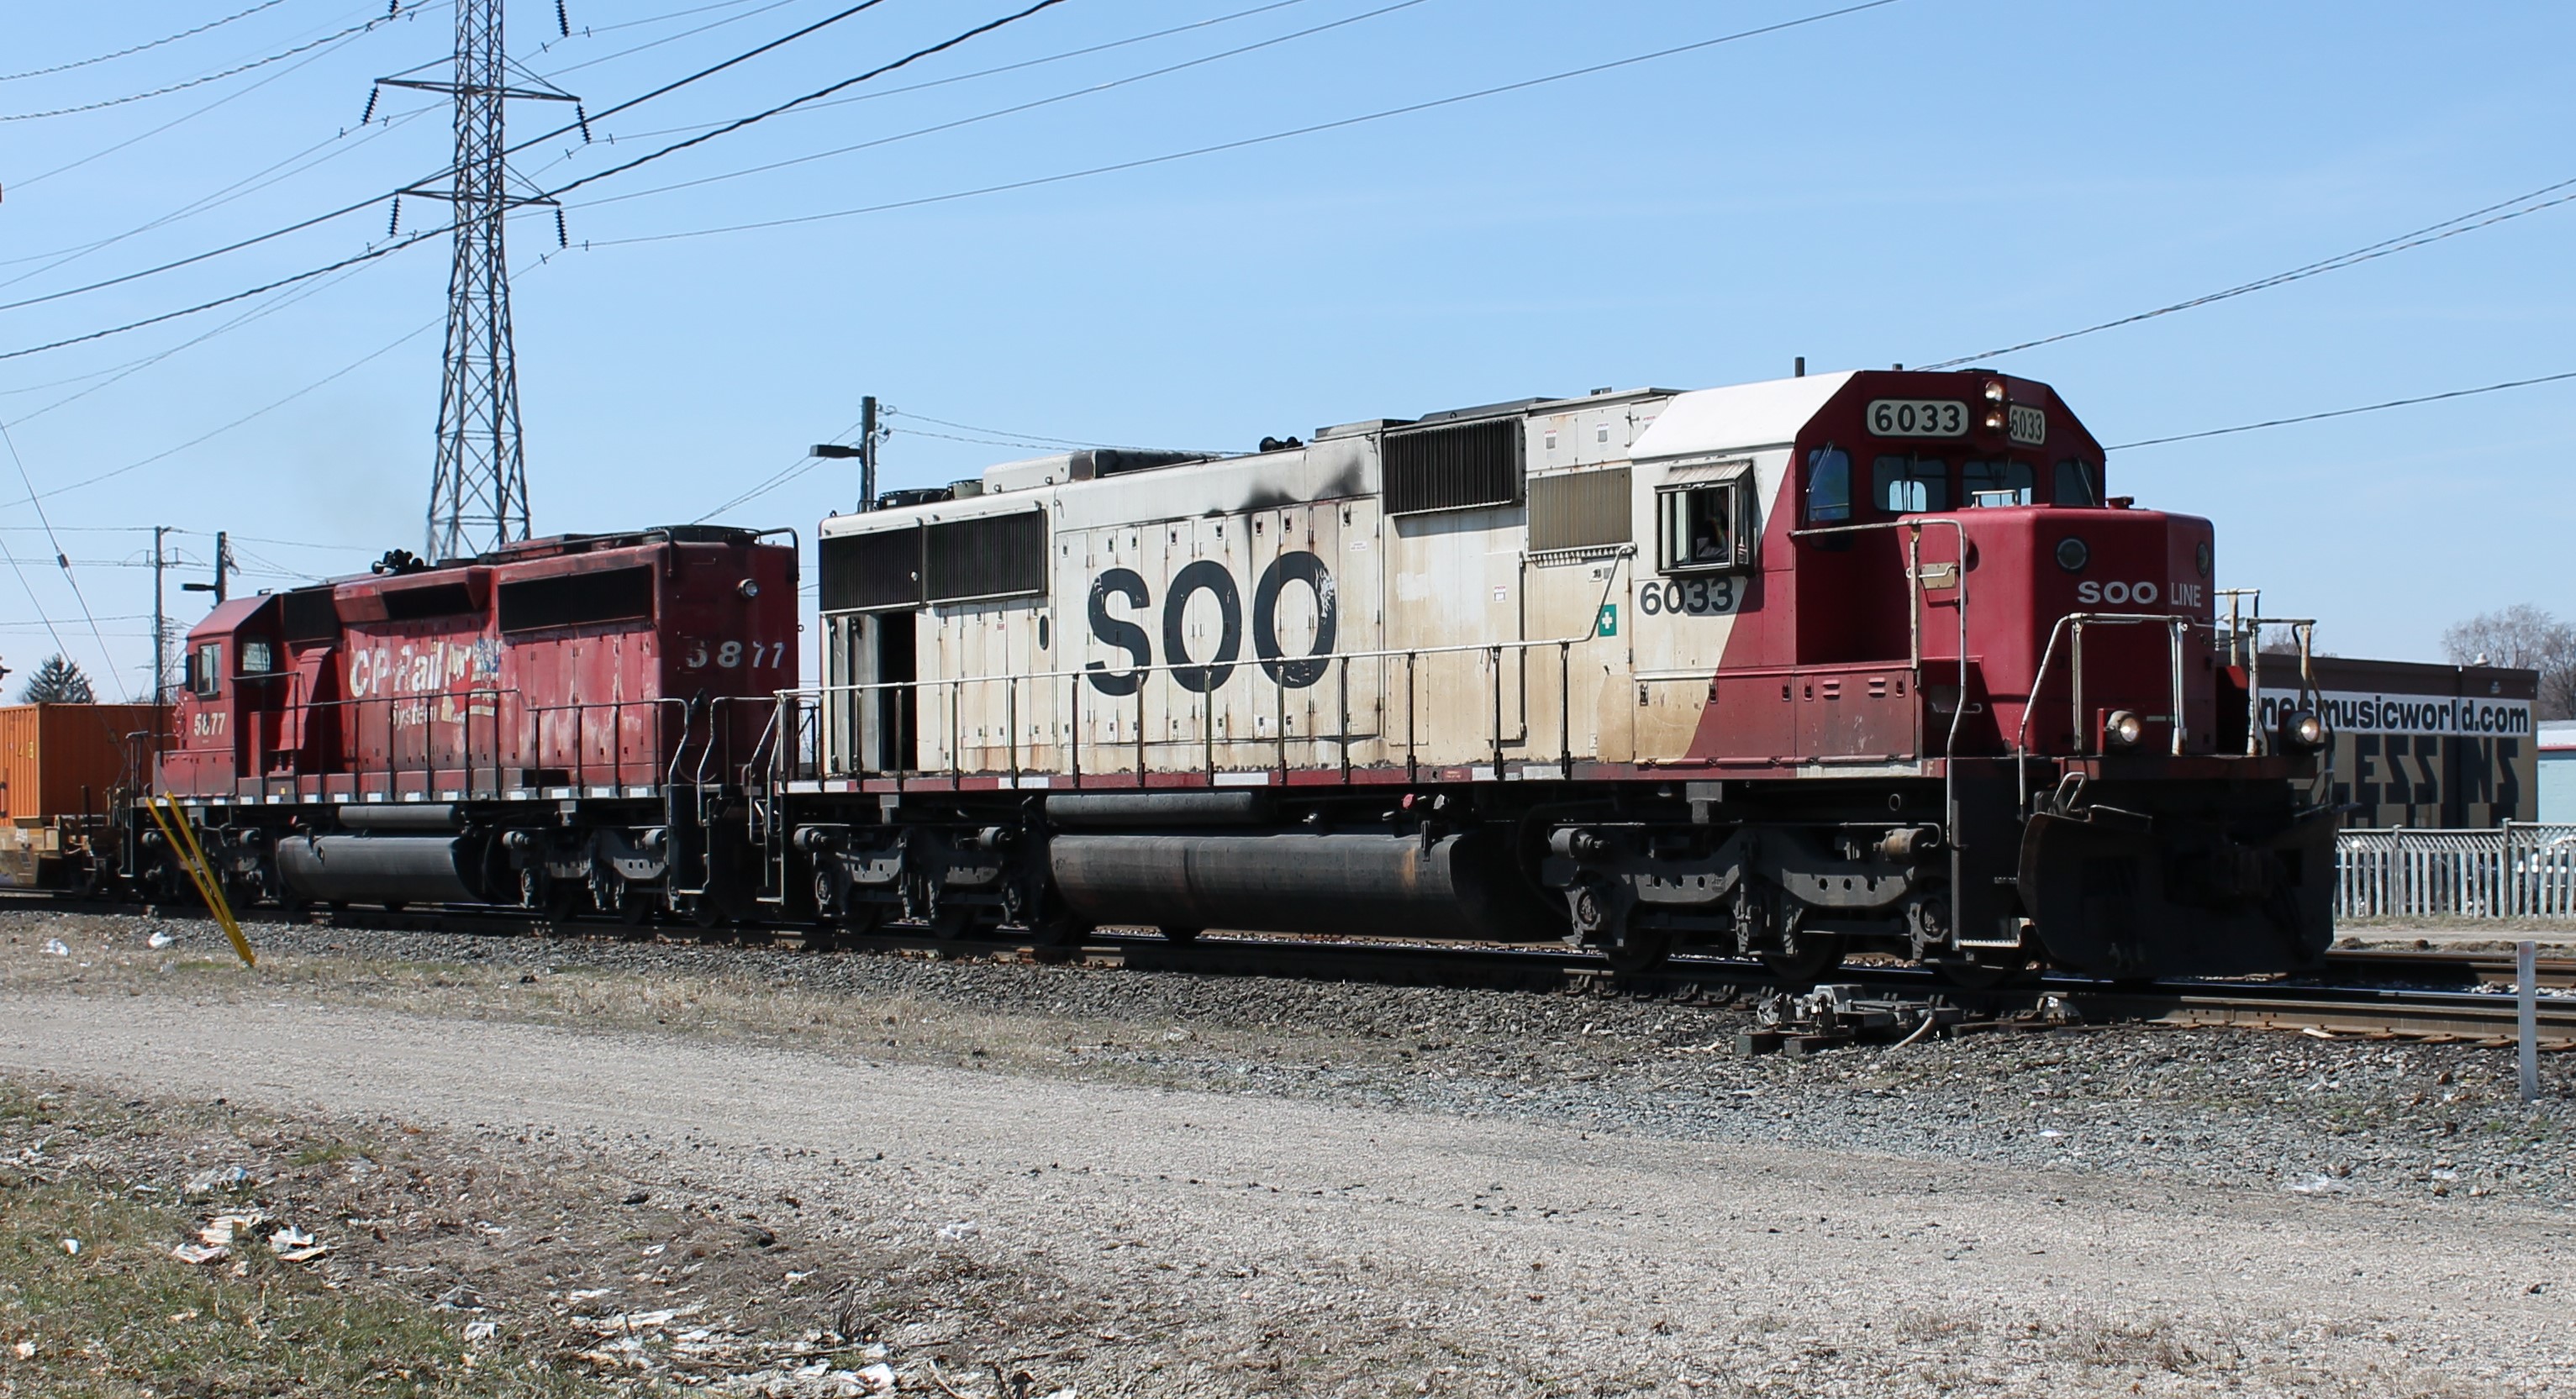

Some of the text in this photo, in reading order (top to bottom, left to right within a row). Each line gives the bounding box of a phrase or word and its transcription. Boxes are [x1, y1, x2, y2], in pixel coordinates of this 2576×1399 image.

[1874, 403, 1961, 434] 6033
[2010, 408, 2043, 441] 6033
[1640, 576, 1734, 616] 6033
[2077, 581, 2202, 607] SOO LINE
[1085, 550, 1336, 697] SOO
[685, 640, 787, 669] 5877
[350, 649, 392, 698] CP
[193, 713, 227, 737] 5877
